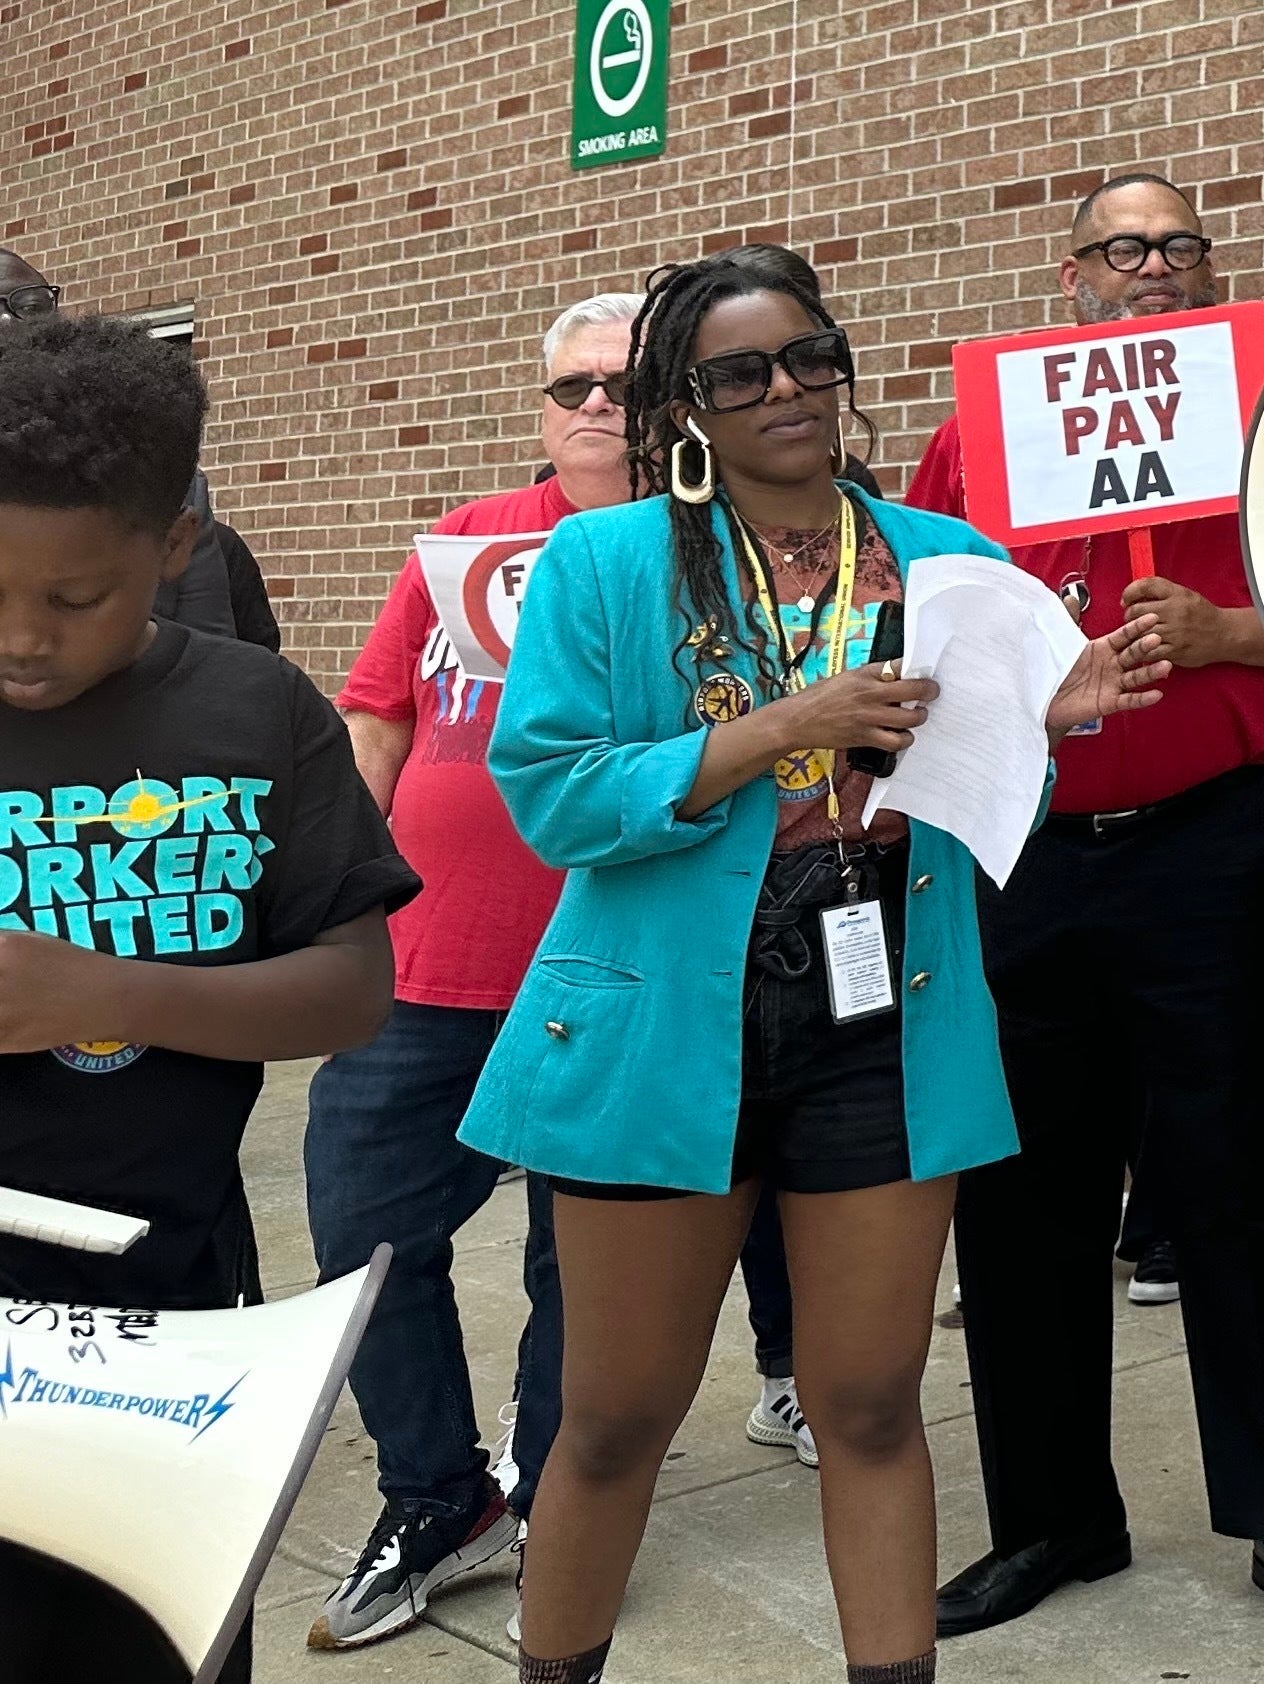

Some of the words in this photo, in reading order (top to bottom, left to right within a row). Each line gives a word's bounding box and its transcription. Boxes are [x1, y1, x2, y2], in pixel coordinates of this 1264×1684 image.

[578, 131, 625, 157] SMOKING
[627, 125, 659, 147] AREA
[1043, 338, 1180, 403] FAIR
[1062, 391, 1182, 456] PAY
[1088, 450, 1175, 509] AA
[74, 1048, 135, 1069] UNITED
[68, 1303, 107, 1364] 32B
[11, 1367, 210, 1428] THUNDERPOWER
